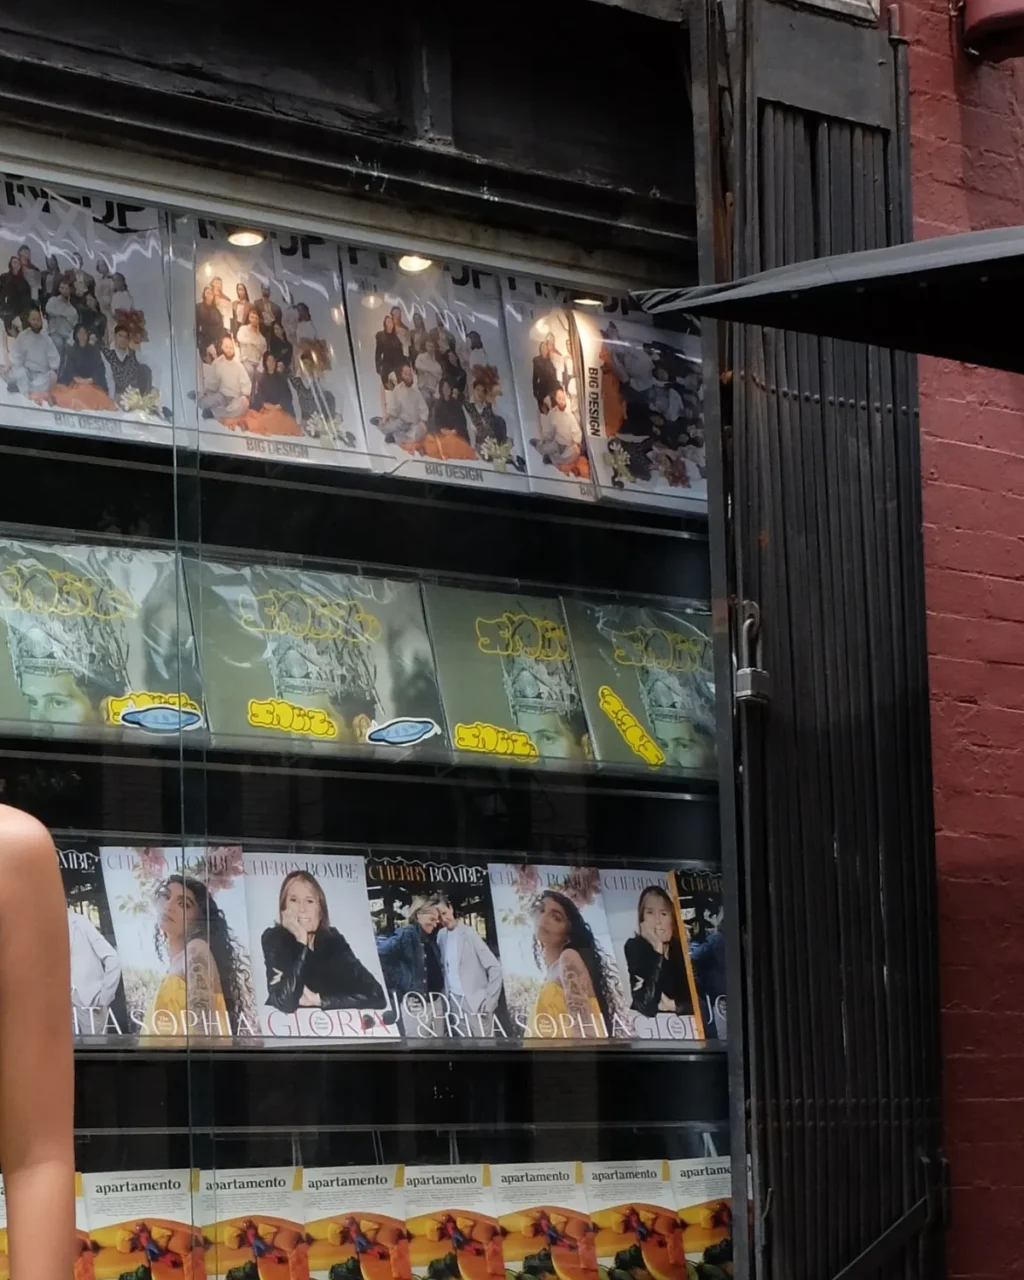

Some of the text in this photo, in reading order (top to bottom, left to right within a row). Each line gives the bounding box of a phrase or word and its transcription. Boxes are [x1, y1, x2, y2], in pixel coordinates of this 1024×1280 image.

[588, 367, 601, 437] BIG DESIGN
[246, 438, 309, 459] BIG DESIGN
[425, 462, 484, 482] BIG DESIGN
[244, 859, 360, 880] CHERRY BOMBE
[369, 864, 483, 884] CHERRY BOMBE
[393, 991, 465, 1022] JODY
[130, 1009, 254, 1036] SOPHIA
[268, 1010, 391, 1036] GLORIA
[417, 1013, 507, 1038] & RITA
[515, 1012, 631, 1039] SOPHIA
[205, 1177, 287, 1193] apartamento
[308, 1175, 388, 1190] apartamento
[406, 1173, 477, 1188] apartamento
[501, 1171, 570, 1185] apartamento
[591, 1169, 657, 1183] apartamento
[96, 1179, 181, 1195] apartamento
